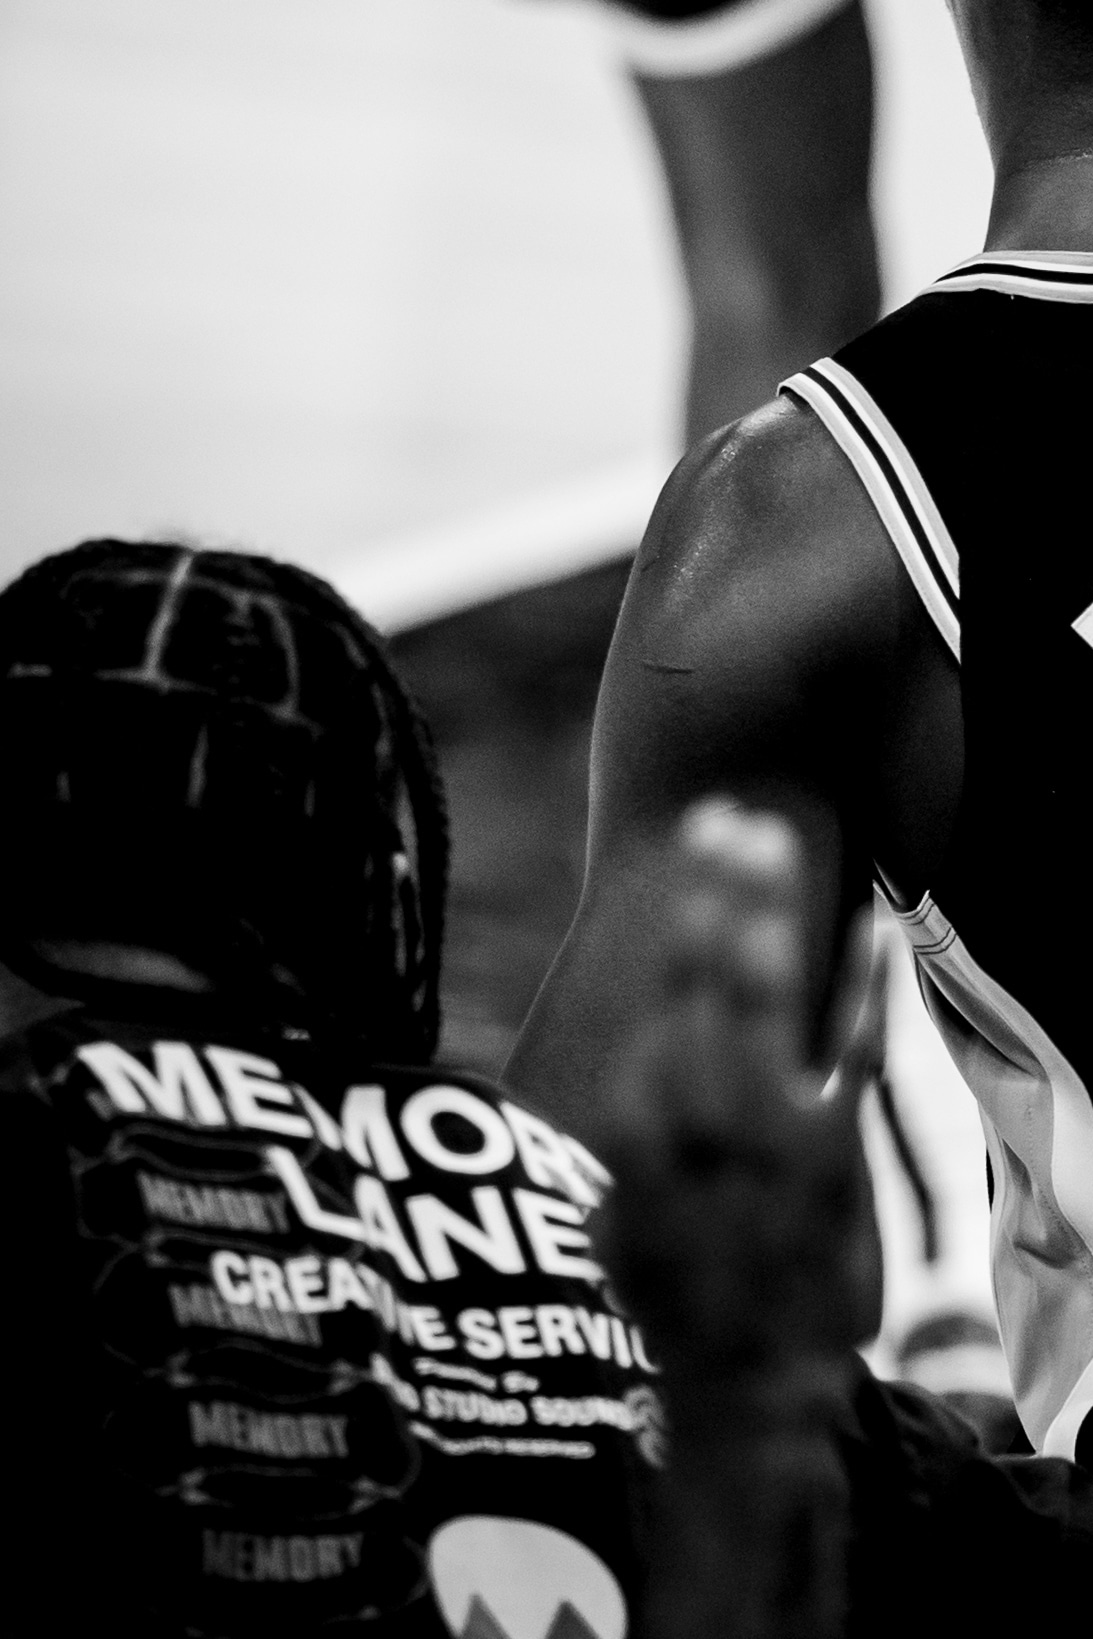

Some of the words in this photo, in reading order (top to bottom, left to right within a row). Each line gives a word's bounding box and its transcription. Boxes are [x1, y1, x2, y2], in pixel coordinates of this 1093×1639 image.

[264, 1143, 606, 1283] LANE
[187, 1399, 350, 1459] MEMORY
[202, 1528, 364, 1583] MEMORY
